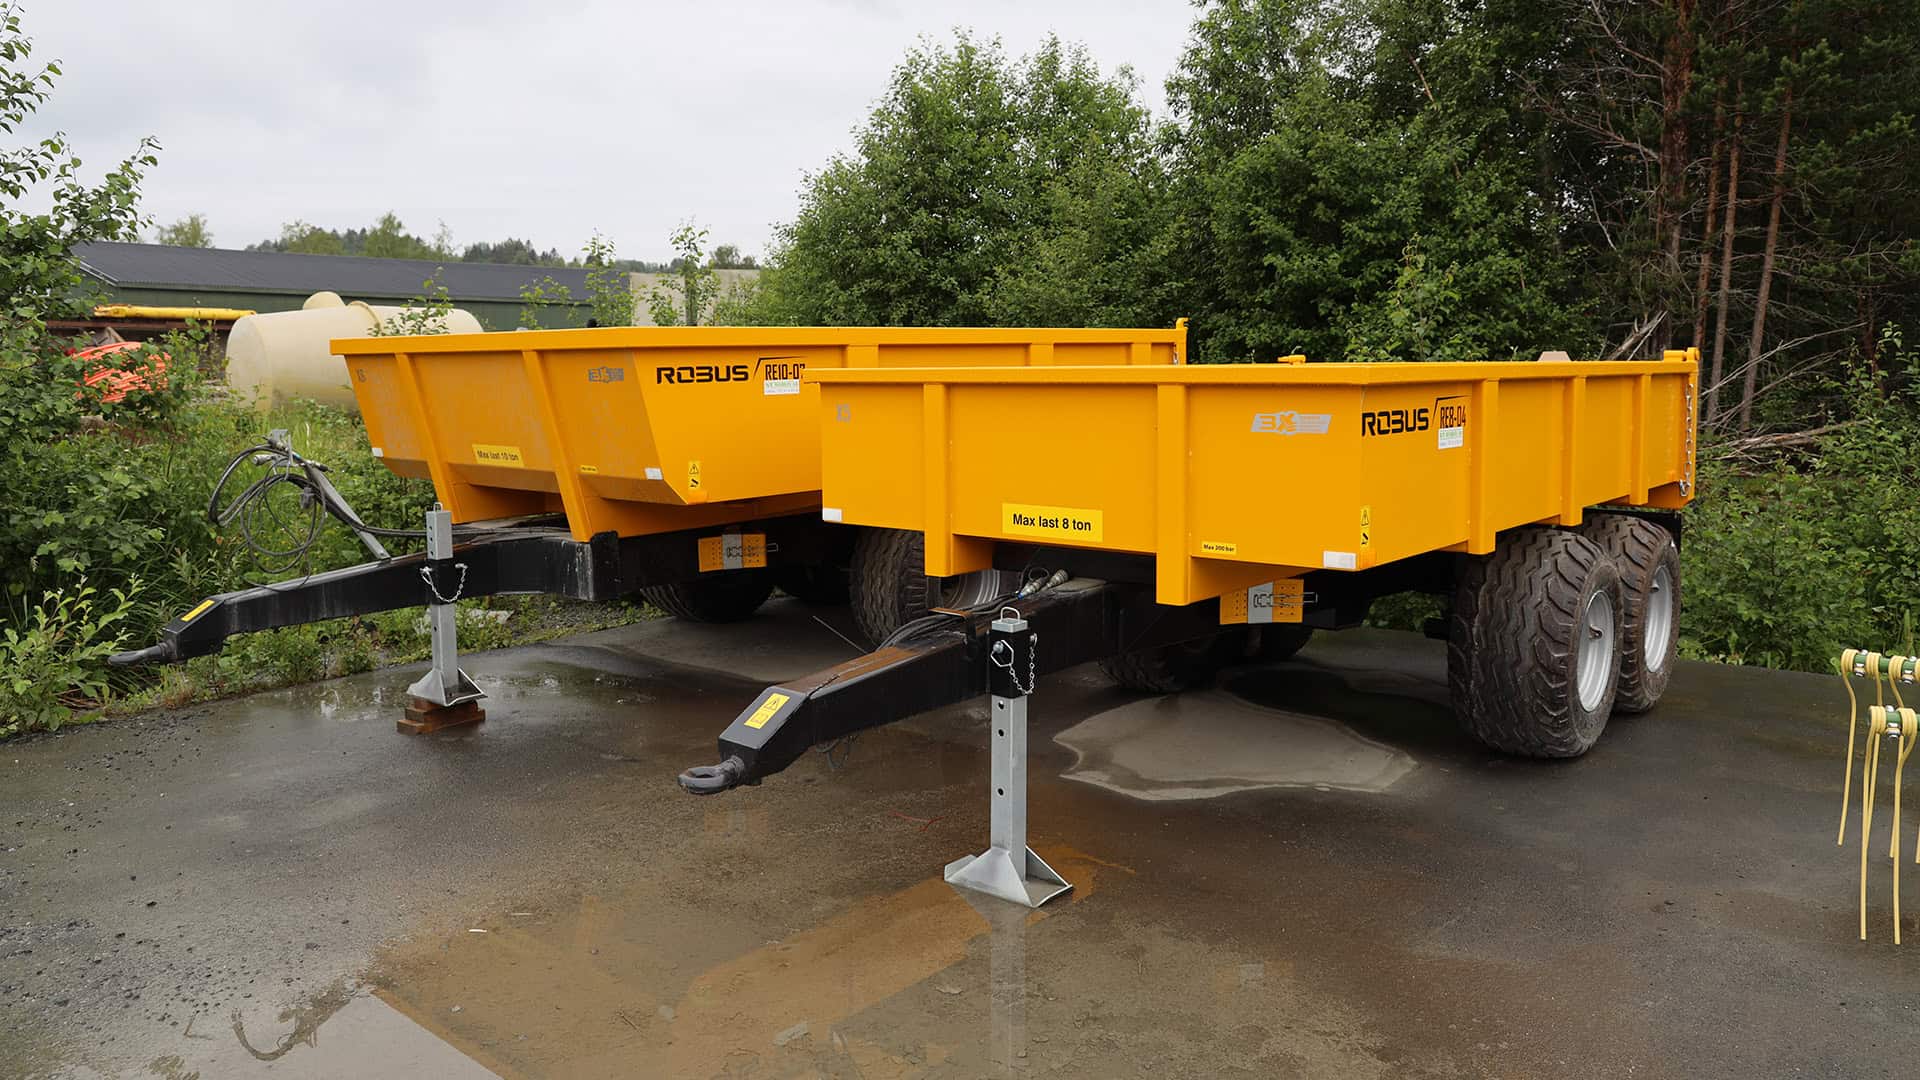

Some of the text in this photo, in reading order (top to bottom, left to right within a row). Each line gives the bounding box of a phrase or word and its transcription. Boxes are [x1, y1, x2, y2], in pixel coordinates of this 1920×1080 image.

[656, 365, 749, 384] ROBUS
[1361, 405, 1466, 437] ROBUS RE8-04
[1013, 513, 1092, 532] Max last 8 ton
